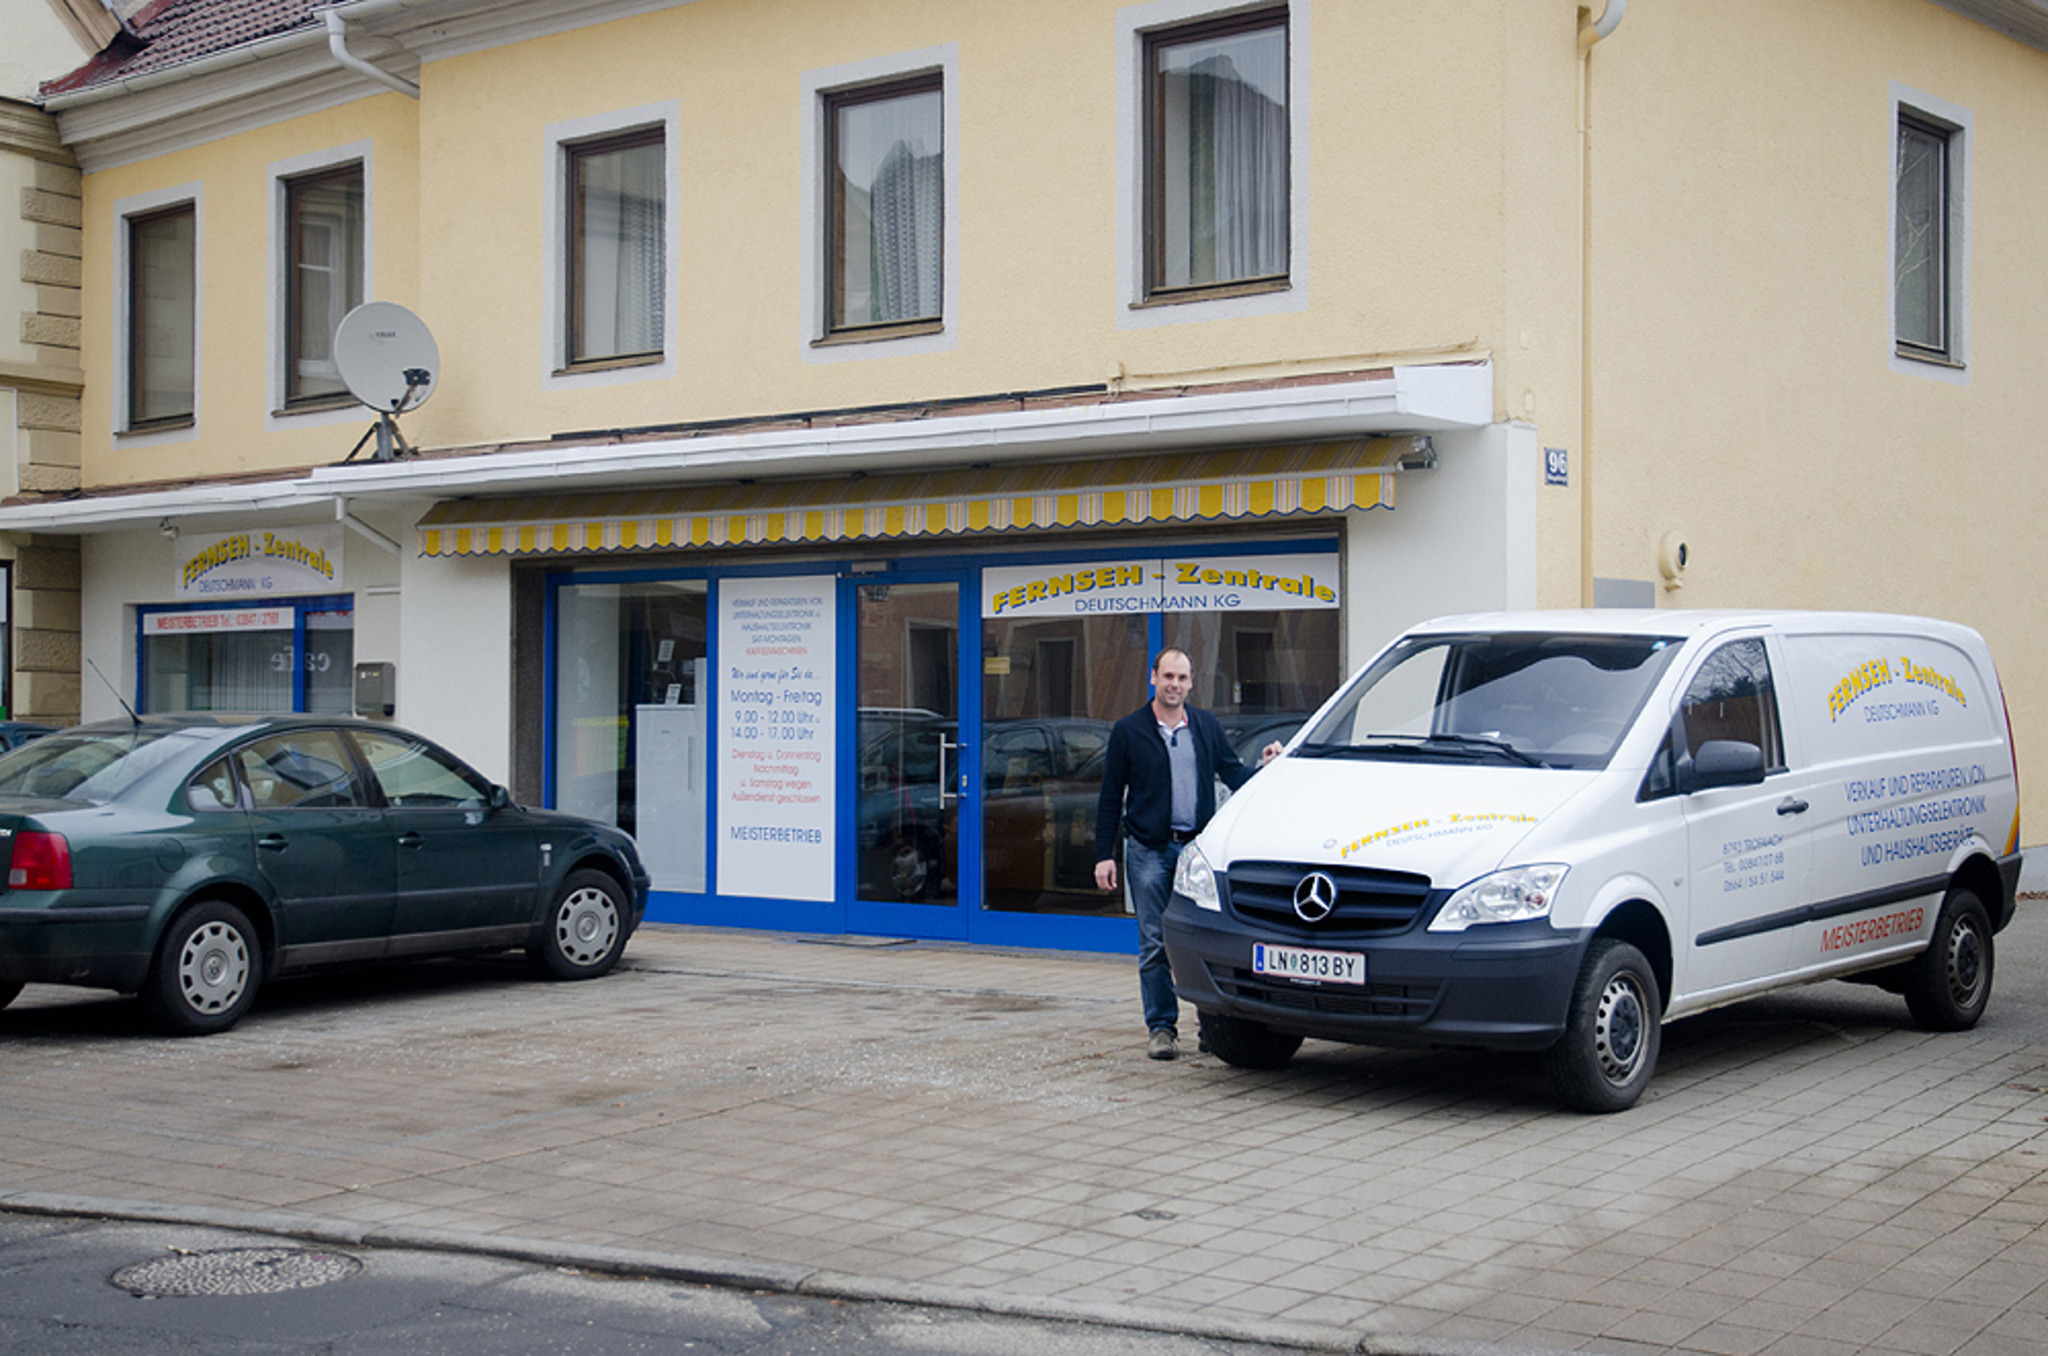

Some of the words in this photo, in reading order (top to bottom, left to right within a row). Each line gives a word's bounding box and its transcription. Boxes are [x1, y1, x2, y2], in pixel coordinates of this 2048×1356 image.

[1549, 452, 1568, 474] 96
[183, 534, 250, 590] FERNSEH
[264, 532, 334, 580] Zentrale
[199, 577, 256, 592] DEUTSCHMANN
[260, 576, 273, 589] KG
[992, 564, 1143, 615] FERNSEH
[1175, 563, 1336, 604] Zentrale
[1075, 594, 1208, 612] DEUTSCHMANN
[1214, 593, 1241, 609] KG
[157, 614, 219, 630] MEISTERBETRIEB
[730, 689, 773, 706] Montag
[784, 689, 822, 707] Freitag
[1827, 656, 1893, 723] FERNSEH
[1899, 656, 1967, 708] Zentrale
[735, 710, 758, 724] 9.00
[768, 710, 795, 723] 12.00
[797, 710, 814, 723] Uhr
[1864, 702, 1926, 723] DEUTSCHMANN
[1927, 699, 1940, 715] KG
[731, 726, 758, 740] 14.00
[768, 726, 795, 740] 17.00
[797, 726, 814, 740] Uhr
[732, 748, 765, 761] Dienstag
[776, 748, 822, 763] Donnerstag
[753, 764, 799, 777] Nachmittag
[750, 777, 783, 790] Samstag
[785, 780, 813, 790] wegen
[1845, 777, 1886, 802] VERKAUF
[1888, 775, 1909, 797] UND
[1909, 767, 1967, 793] REPARATUREN
[1966, 764, 1986, 784] VON
[1847, 795, 1988, 837] UNTERHALTUNGSELEKTRONIK
[730, 826, 822, 844] MEISTERBETRIEB
[1341, 818, 1430, 859] FERNSEH
[1449, 813, 1538, 823] Zentrale
[1386, 826, 1473, 847] DEUTSCHMANN
[1861, 844, 1883, 867] UND
[1885, 823, 1976, 862] HAUSHALTSGERÄTE
[1820, 906, 1924, 953] MEISTERBETRIEB
[1269, 950, 1287, 971] LN
[1300, 953, 1329, 976] 813
[1333, 956, 1355, 977] BY
